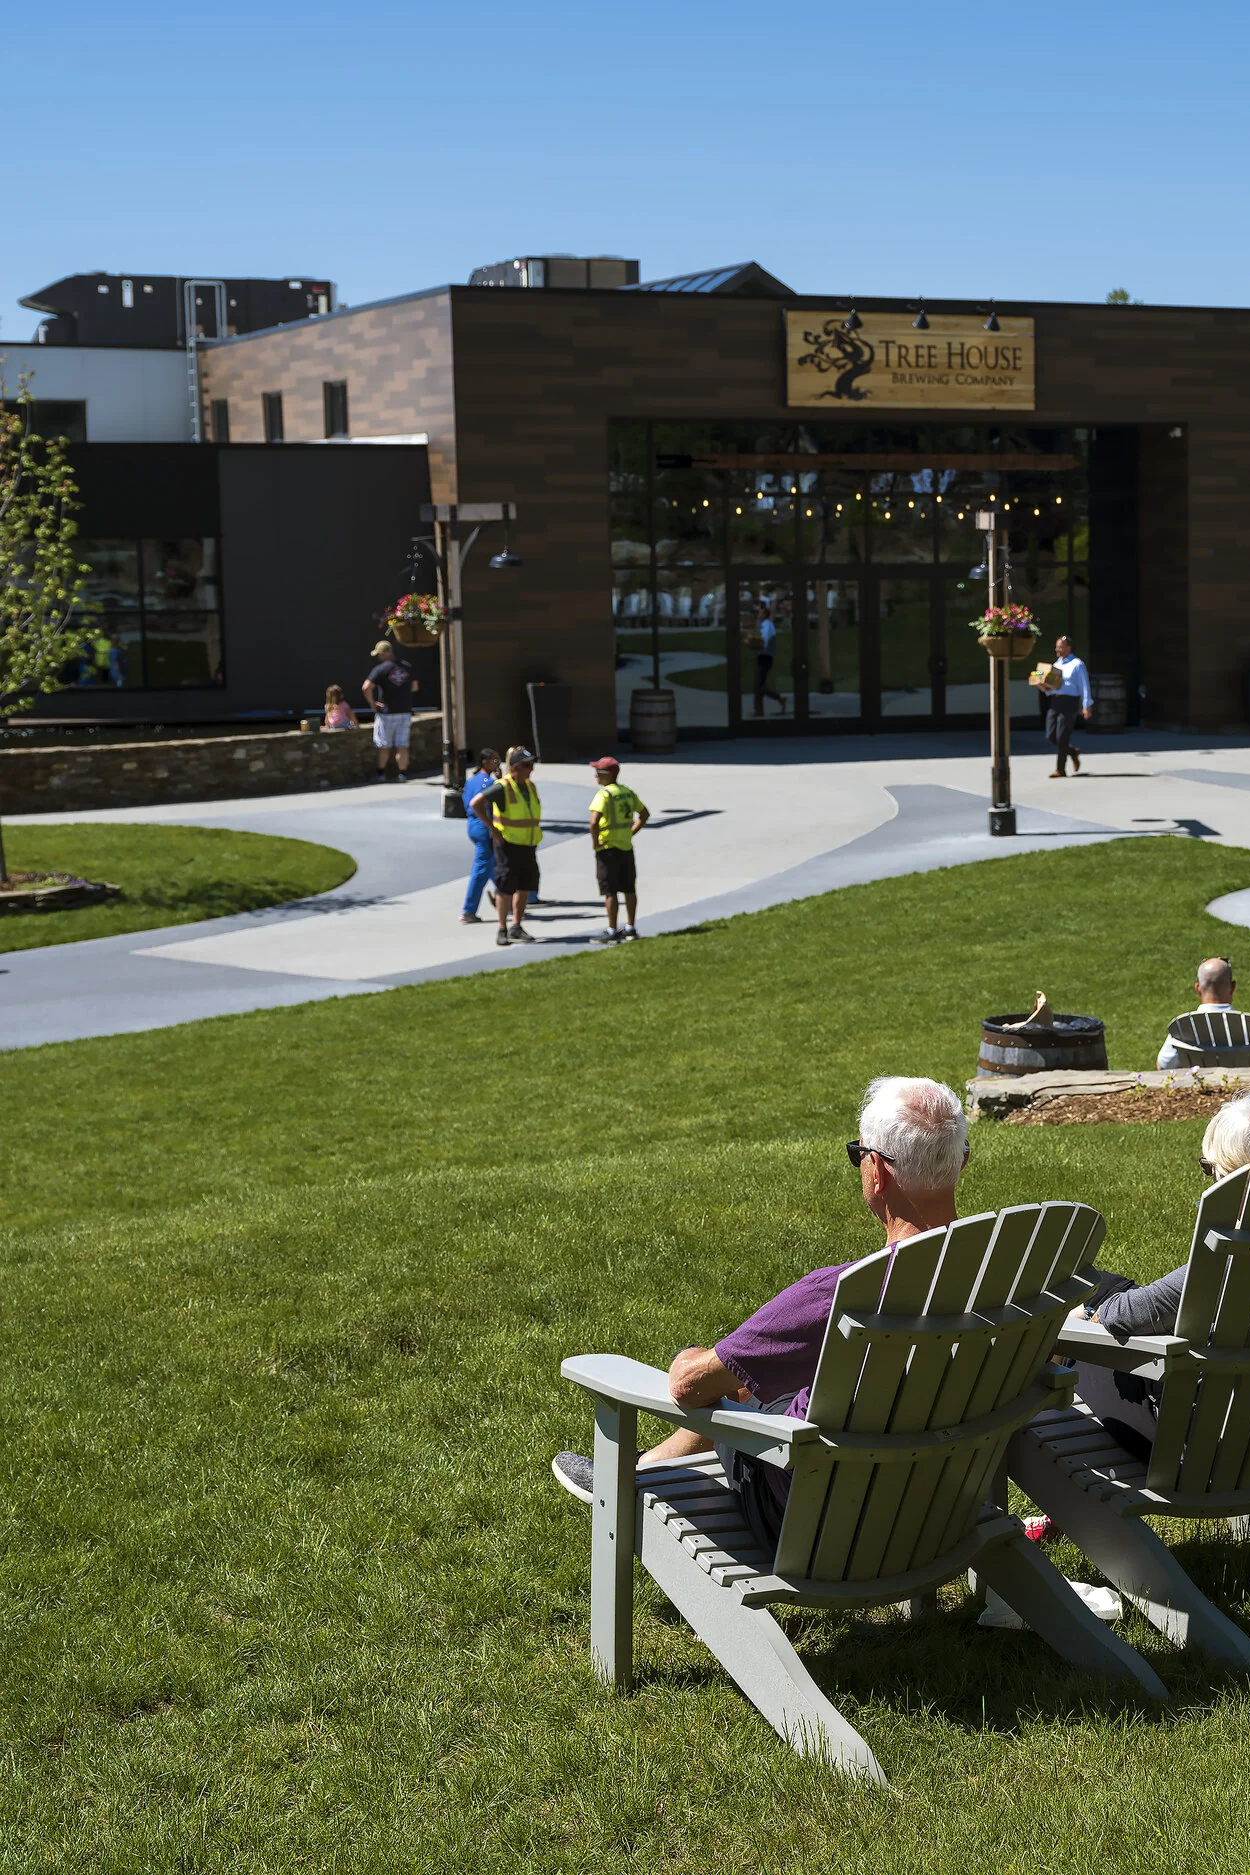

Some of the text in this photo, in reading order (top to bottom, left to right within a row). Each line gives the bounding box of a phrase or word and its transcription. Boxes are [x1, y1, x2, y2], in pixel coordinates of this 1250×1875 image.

[879, 339, 1023, 371] TREE HOUSE
[891, 372, 1016, 387] BREWING COMPANY
